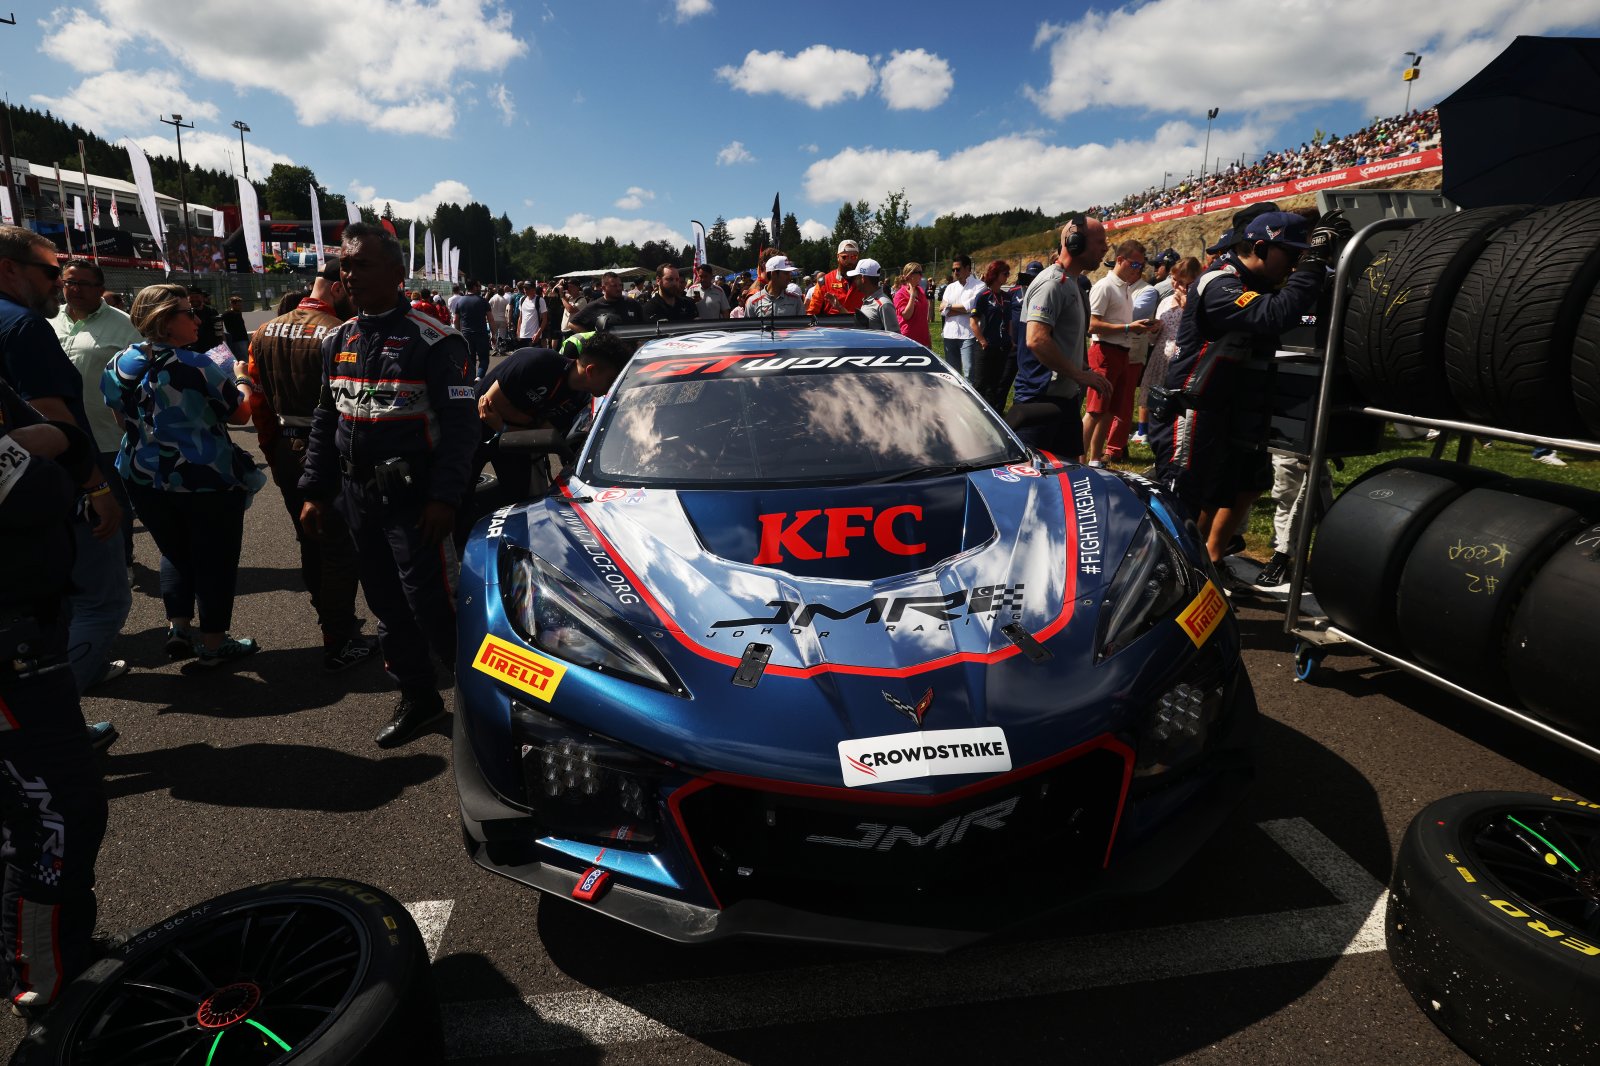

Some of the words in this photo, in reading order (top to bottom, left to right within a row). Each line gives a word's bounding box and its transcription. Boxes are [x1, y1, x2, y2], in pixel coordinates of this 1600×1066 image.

[1299, 172, 1347, 188] CROWDSTRIKE
[1364, 156, 1422, 174] CROWDSTRIKE
[1243, 186, 1284, 201] CROWDSTRIKE
[635, 353, 777, 378] GT
[741, 355, 931, 371] WORLD
[753, 505, 926, 566] KFC
[1073, 476, 1101, 575] #FIGHTLIKEJALIL
[706, 627, 830, 640] JOHOR
[887, 612, 1022, 632] RACING
[710, 589, 968, 629] JMR
[1184, 587, 1224, 640] PIRELLI
[480, 641, 555, 692] PIRELLI
[859, 741, 1005, 768] CROWDSTRIKE
[805, 796, 1021, 852] JMR
